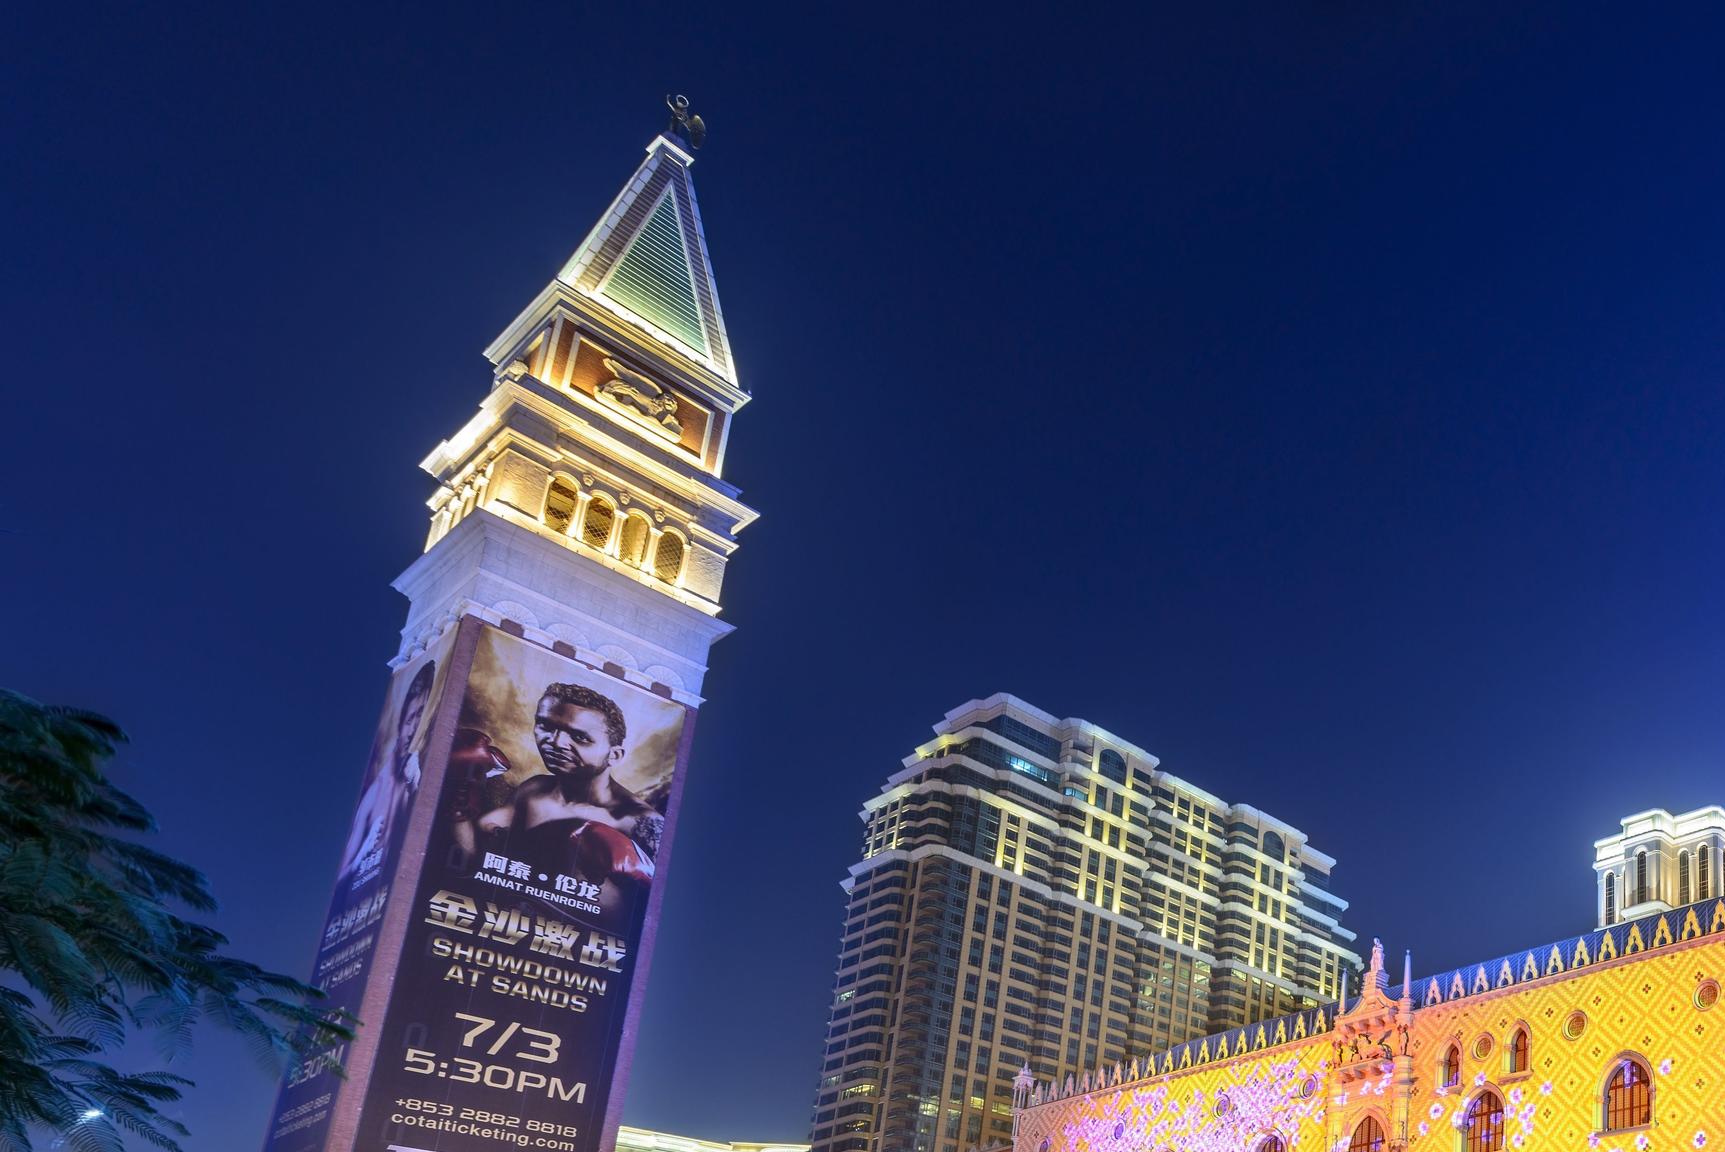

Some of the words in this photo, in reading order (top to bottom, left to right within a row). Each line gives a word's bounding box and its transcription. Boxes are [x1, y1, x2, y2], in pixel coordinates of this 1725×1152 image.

[474, 871, 524, 892] AMNAT
[525, 886, 601, 915] RUENROENG
[424, 889, 626, 973] 金沙激战
[431, 936, 608, 996] SHOWDOWN
[443, 964, 485, 988] AT
[491, 976, 589, 1013] SANDS
[454, 1012, 562, 1064] 7/3
[404, 1048, 588, 1105] 5:30PM
[391, 1113, 575, 1152] cotaiticketing.com
[395, 1098, 454, 1117] +853
[459, 1107, 521, 1128] 2882
[525, 1119, 578, 1138] 8818
